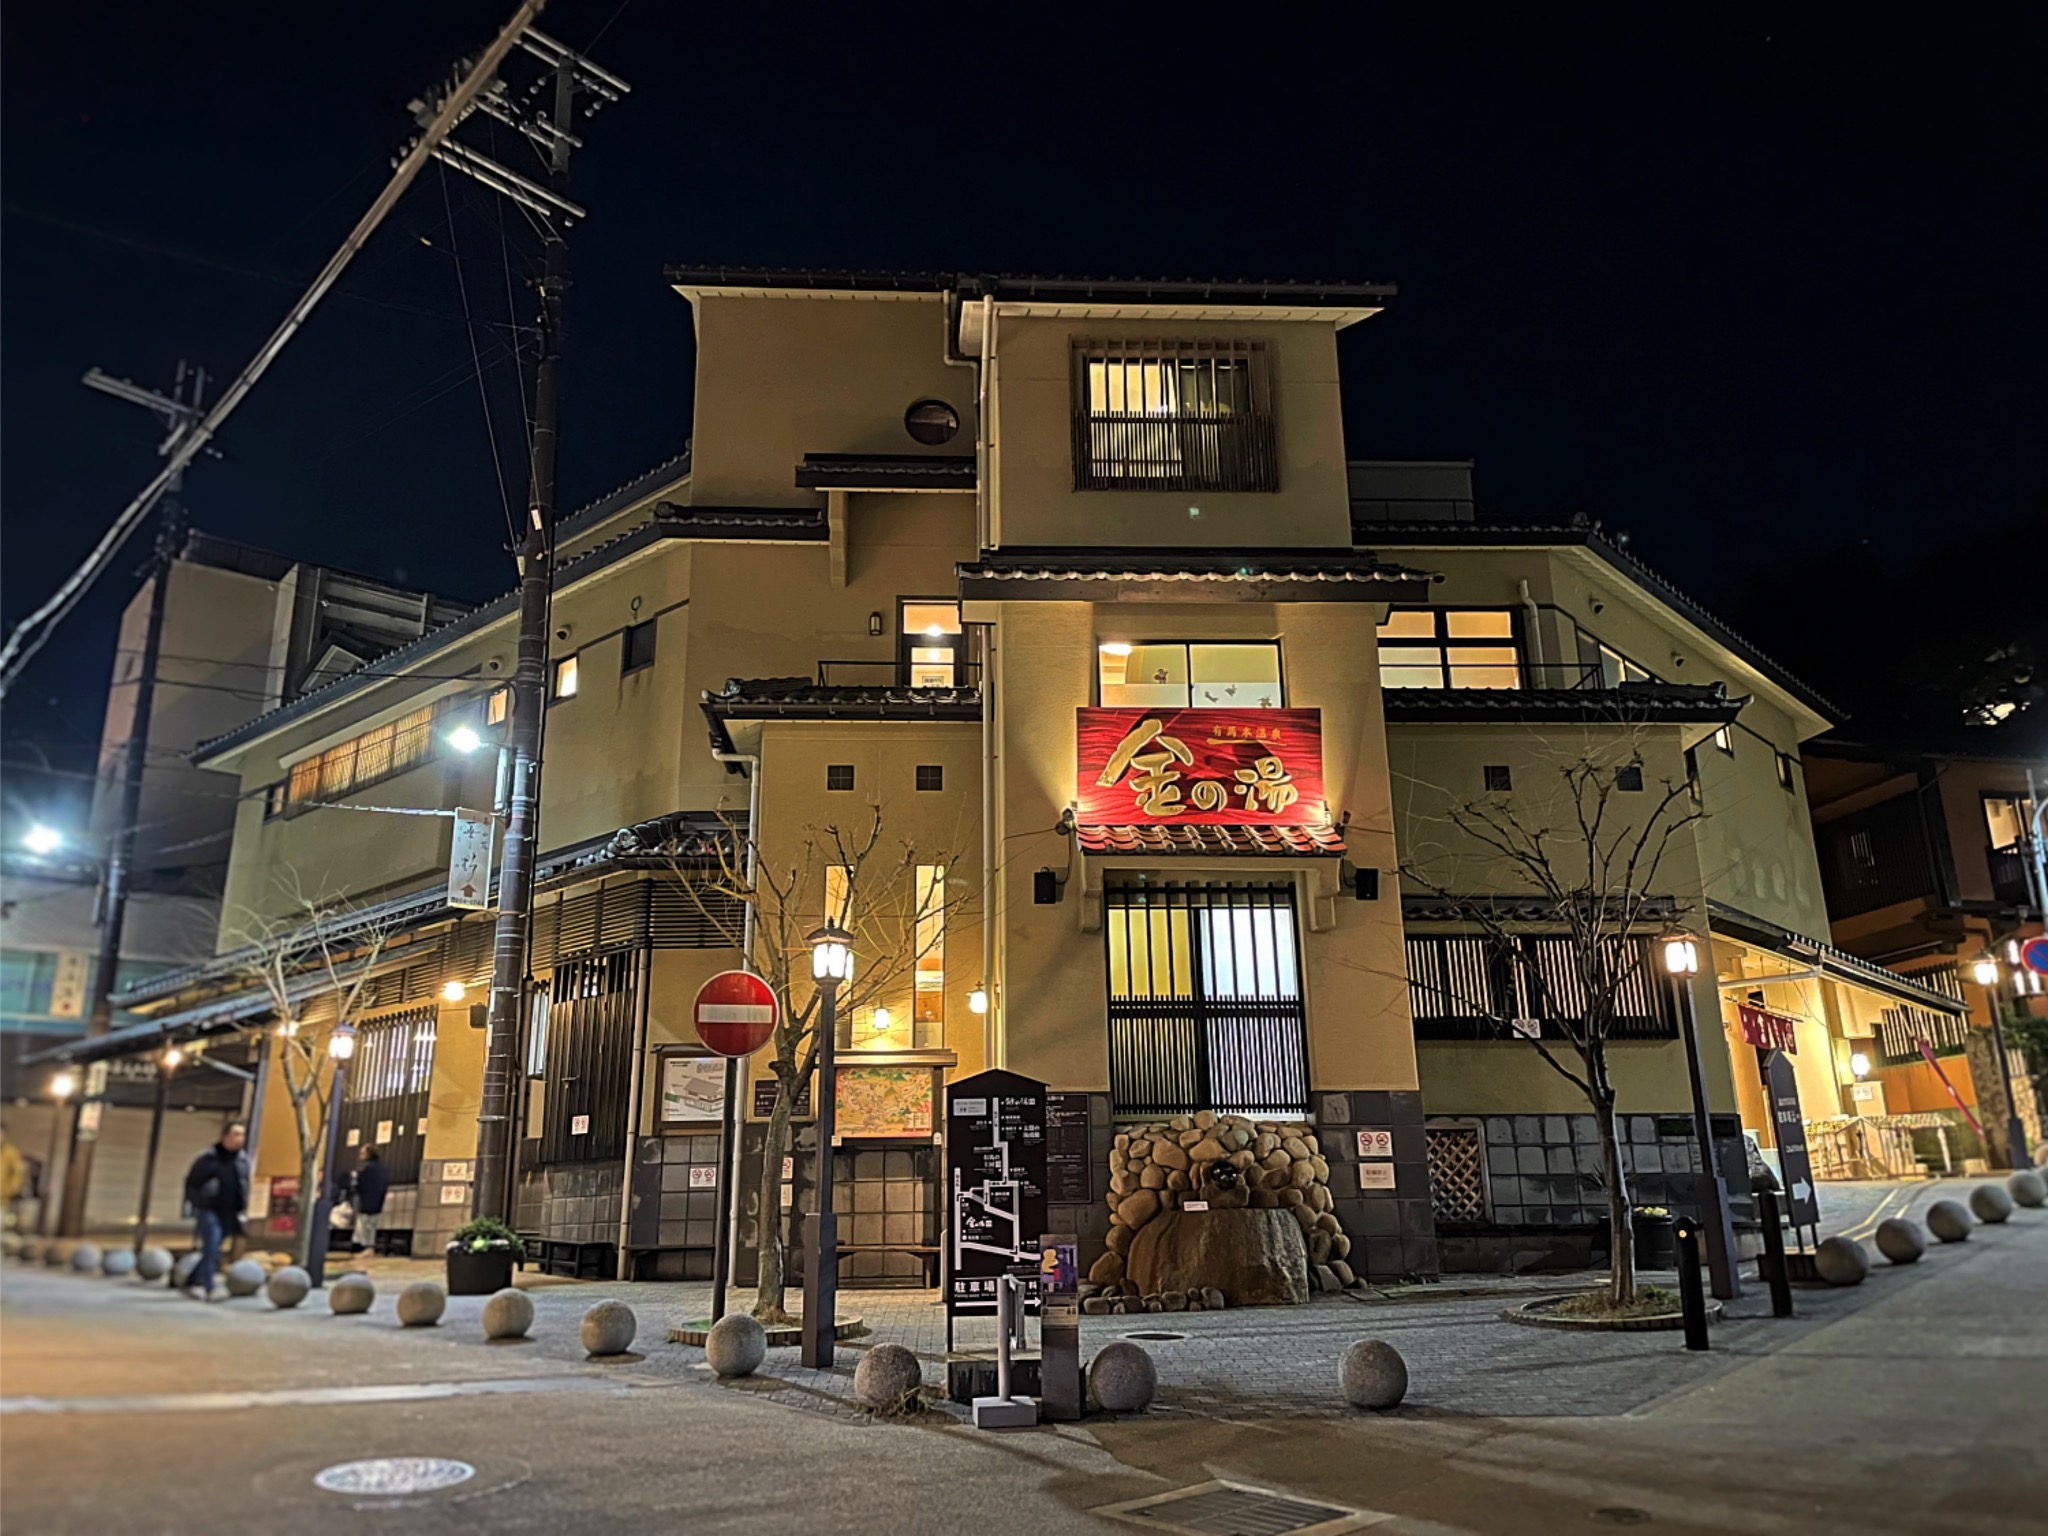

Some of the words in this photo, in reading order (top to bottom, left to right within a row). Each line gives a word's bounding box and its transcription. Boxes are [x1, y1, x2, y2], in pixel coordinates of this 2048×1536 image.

[1212, 724, 1282, 740] 有馬本温泉
[1095, 718, 1299, 817] 金の湯
[954, 1280, 995, 1293] 駐車場
